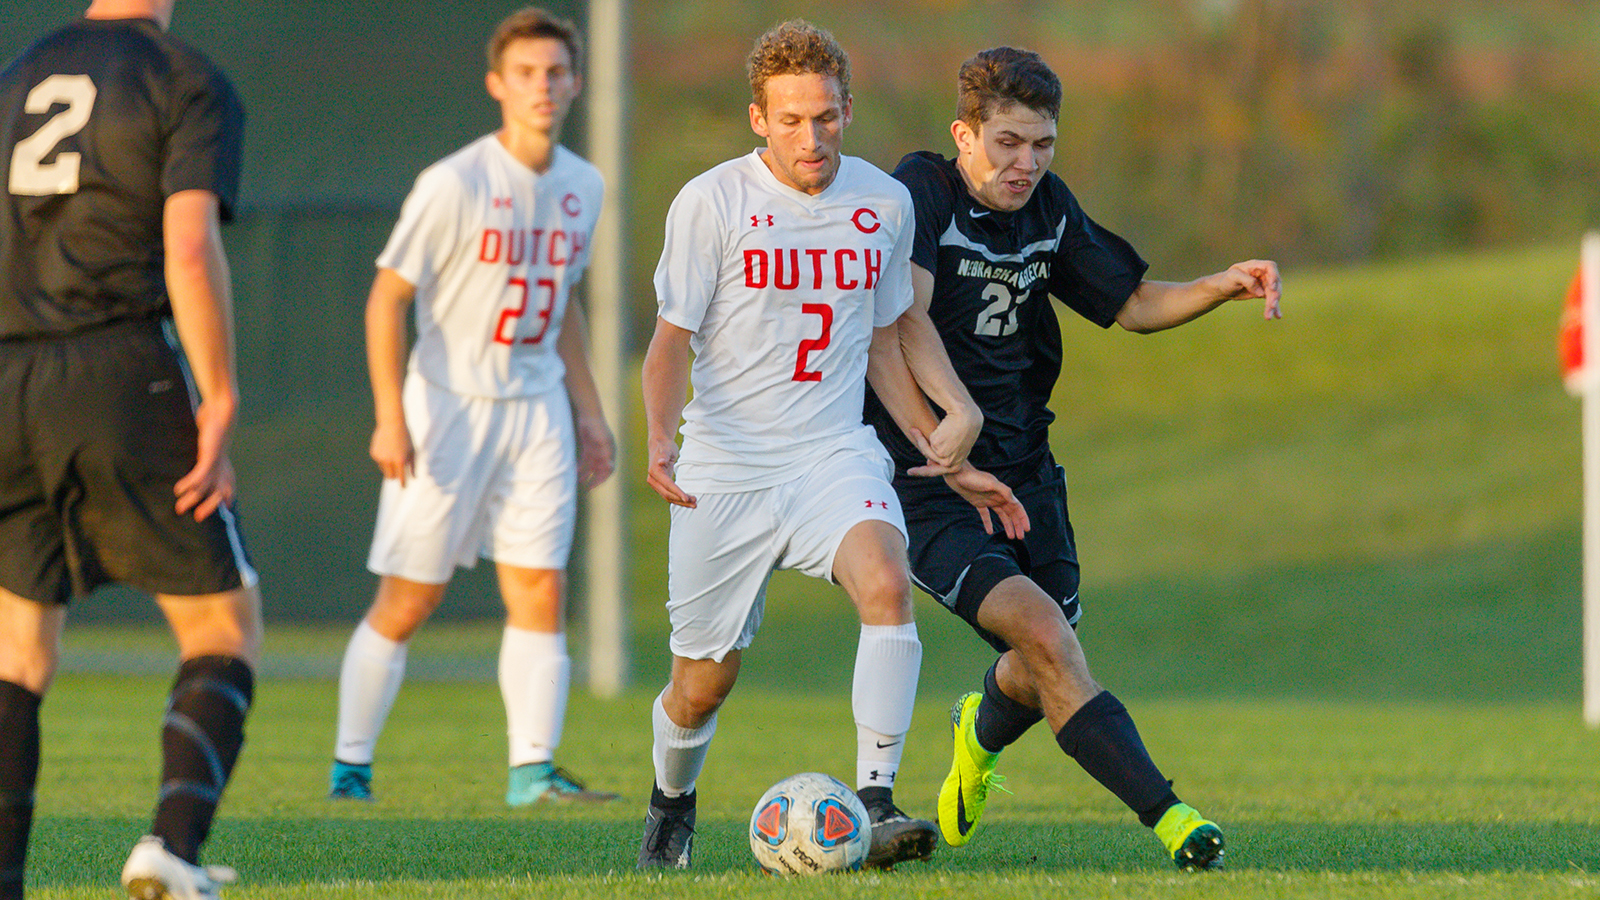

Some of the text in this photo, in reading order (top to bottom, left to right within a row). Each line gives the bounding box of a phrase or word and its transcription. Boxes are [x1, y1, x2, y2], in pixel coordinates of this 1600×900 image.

[8, 73, 98, 196] 2
[478, 228, 587, 266] DUTCH
[850, 208, 881, 234] C
[743, 248, 882, 290] DUTCH
[493, 277, 557, 346] 23
[791, 303, 834, 382] 2
